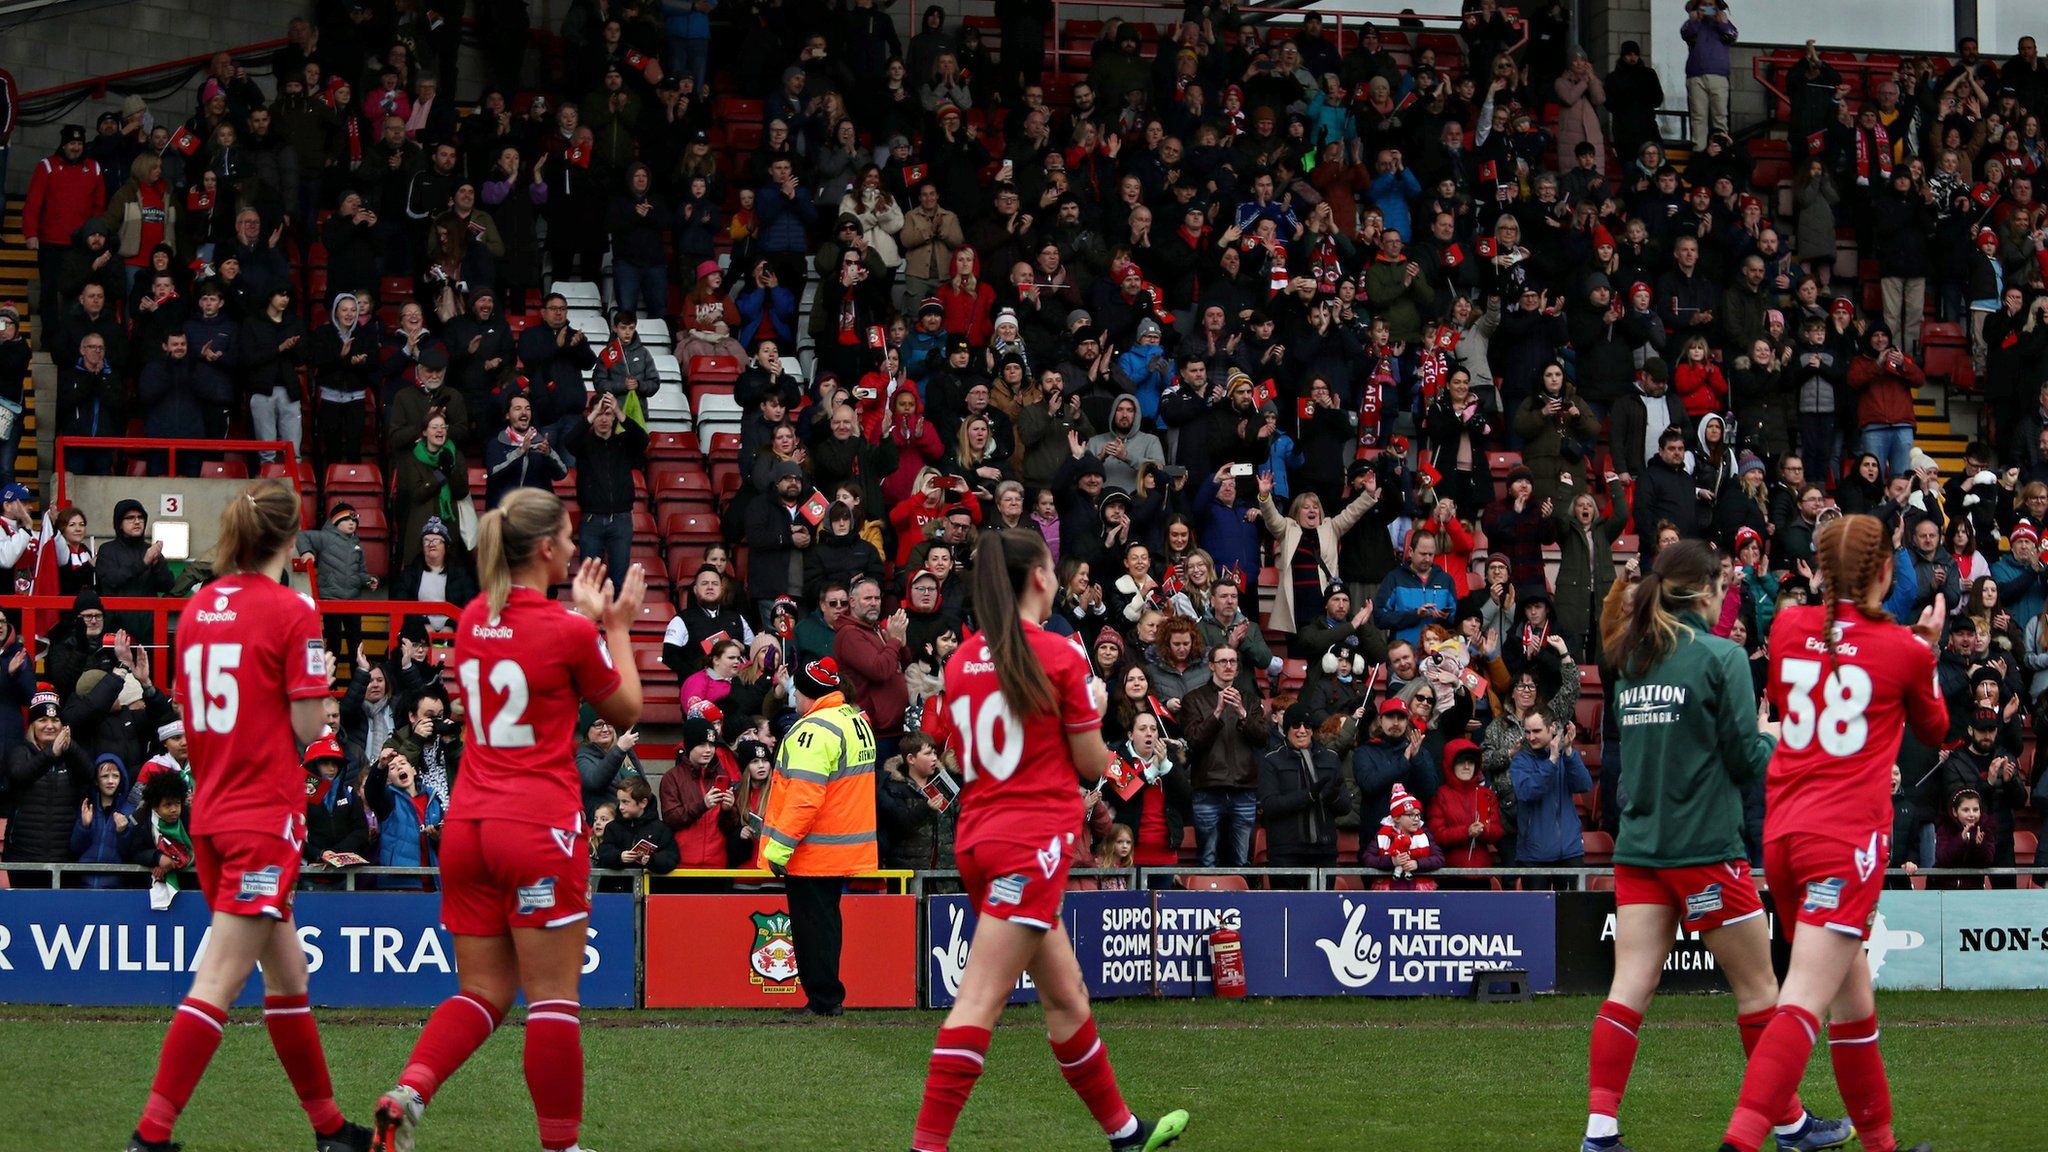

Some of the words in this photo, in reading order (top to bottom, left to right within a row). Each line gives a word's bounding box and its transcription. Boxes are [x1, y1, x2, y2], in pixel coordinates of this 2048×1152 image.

[1364, 385, 1376, 413] AFC
[166, 497, 178, 513] 3
[196, 609, 238, 625] Expedia
[472, 624, 514, 640] Expedia
[1805, 636, 1859, 657] Expdia
[184, 643, 243, 735] 15
[1619, 684, 1686, 709] AVIATION
[459, 658, 537, 748] 12
[1780, 657, 1873, 757] 38
[797, 731, 814, 749] 41
[852, 717, 873, 748] 41
[950, 690, 1024, 783] 10
[1102, 907, 1242, 930] SUPPORTING
[1388, 908, 1441, 930] THE
[30, 924, 324, 973] WILLIS
[340, 926, 600, 974] TRAS
[1102, 934, 1214, 957] COMMUNIT
[1389, 934, 1522, 956] NATIONAL
[1102, 960, 1212, 983] FOOTBALL
[1663, 950, 1714, 970] RICAN
